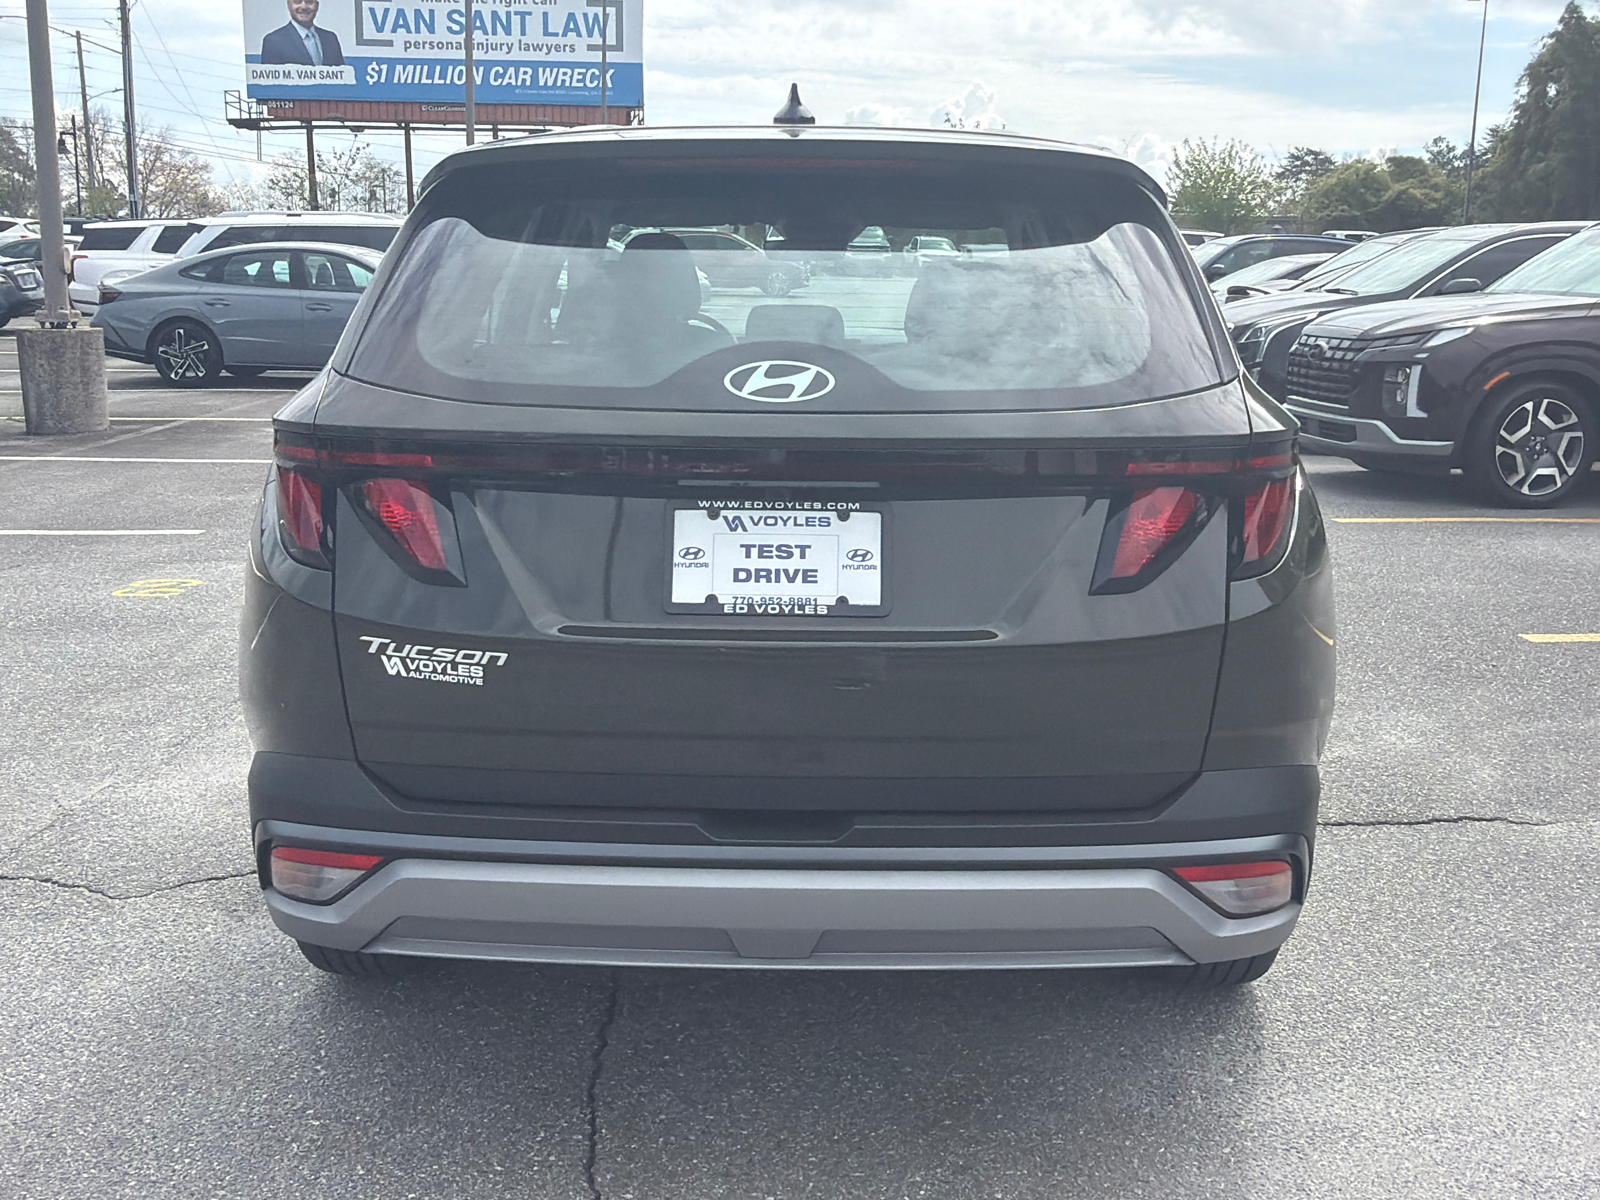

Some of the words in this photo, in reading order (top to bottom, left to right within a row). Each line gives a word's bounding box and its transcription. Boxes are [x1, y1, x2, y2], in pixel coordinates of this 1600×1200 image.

[368, 6, 436, 35] VAN
[446, 9, 533, 36] SANT
[542, 11, 610, 39] LAW
[403, 39, 466, 52] personal
[473, 40, 514, 54] injury
[518, 39, 577, 55] lawyers
[251, 69, 281, 80] DAVID
[282, 70, 295, 80] M.
[297, 70, 317, 80] VAN
[318, 70, 345, 80] SANT
[365, 61, 387, 85] $1
[392, 64, 484, 85] MILLION
[489, 66, 533, 86] CAR
[538, 67, 615, 88] WRECK
[697, 500, 861, 510] WWW.EDVOYLES.COM
[749, 515, 832, 528] VOYLES
[740, 544, 812, 560] TEST
[732, 568, 819, 584] DRIVE
[723, 605, 748, 614] ED
[754, 605, 828, 615] VOYLES
[405, 658, 484, 678] VOYLES
[408, 671, 484, 686] AUTOMOTIVE
